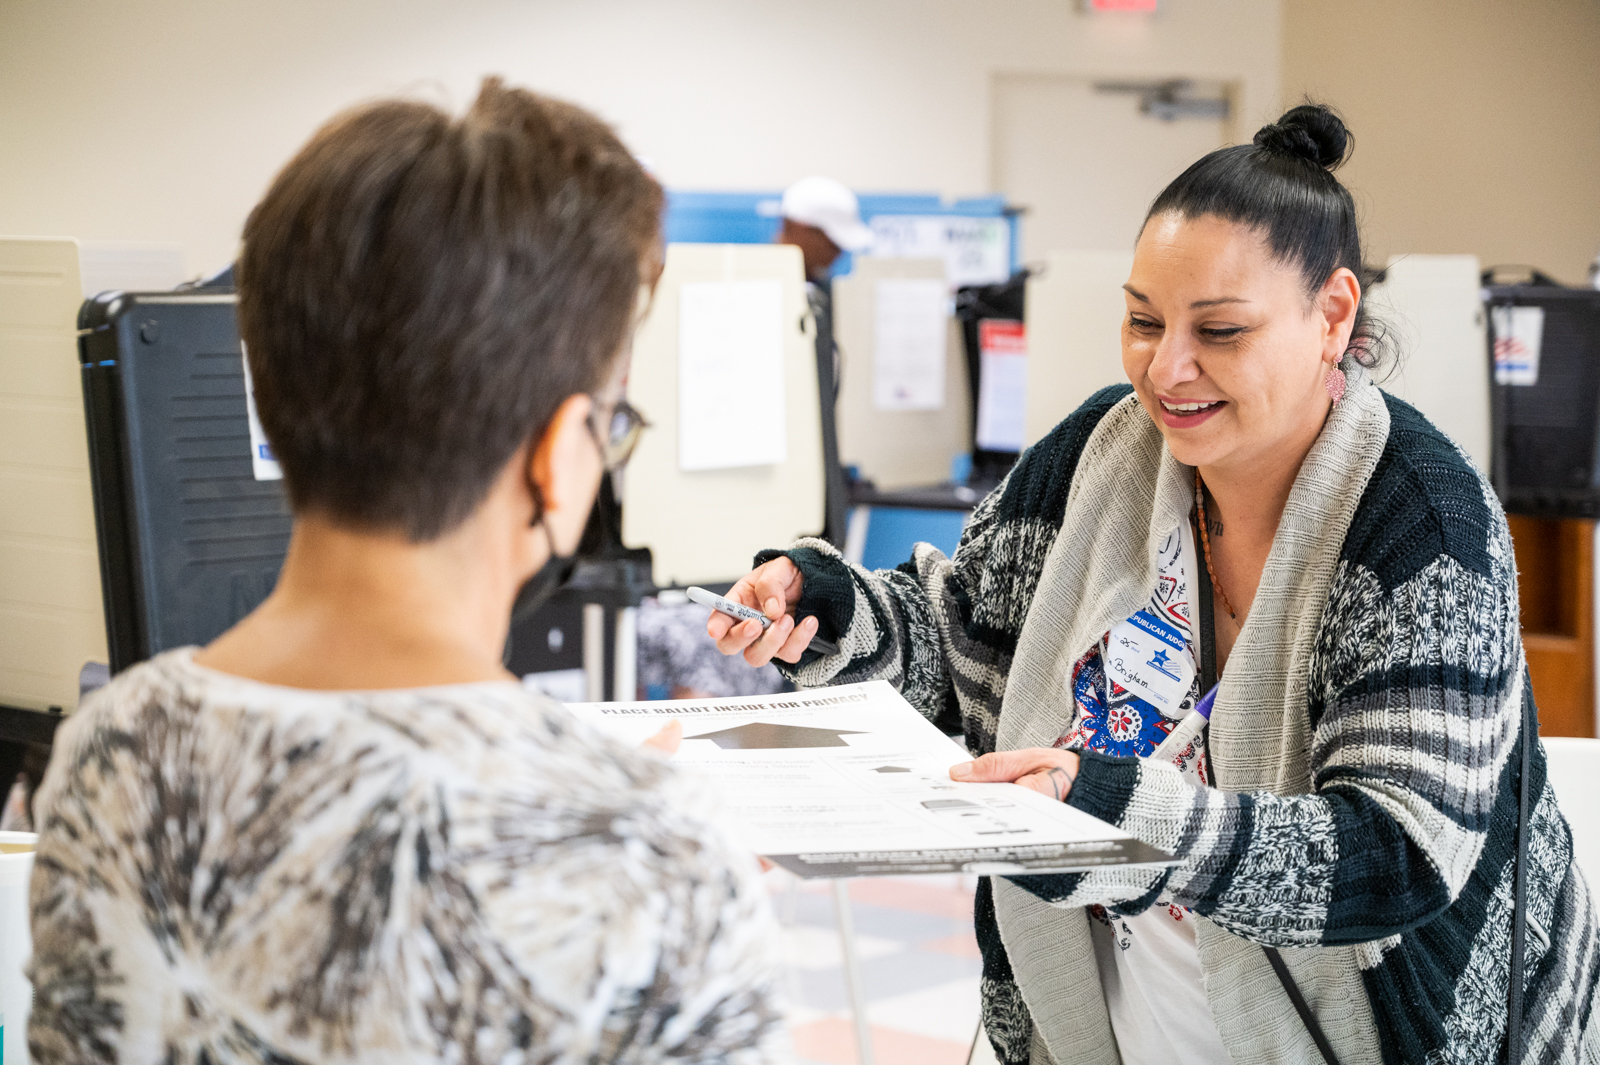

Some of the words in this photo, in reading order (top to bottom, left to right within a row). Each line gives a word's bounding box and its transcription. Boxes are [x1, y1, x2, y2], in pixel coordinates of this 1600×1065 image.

[1130, 613, 1167, 638] EPUBLICAN
[1114, 657, 1149, 689] Brigham
[653, 706, 711, 714] BALLOT
[713, 703, 768, 712] INSIDE
[769, 701, 801, 709] FOR
[801, 693, 869, 707] PRIVACY
